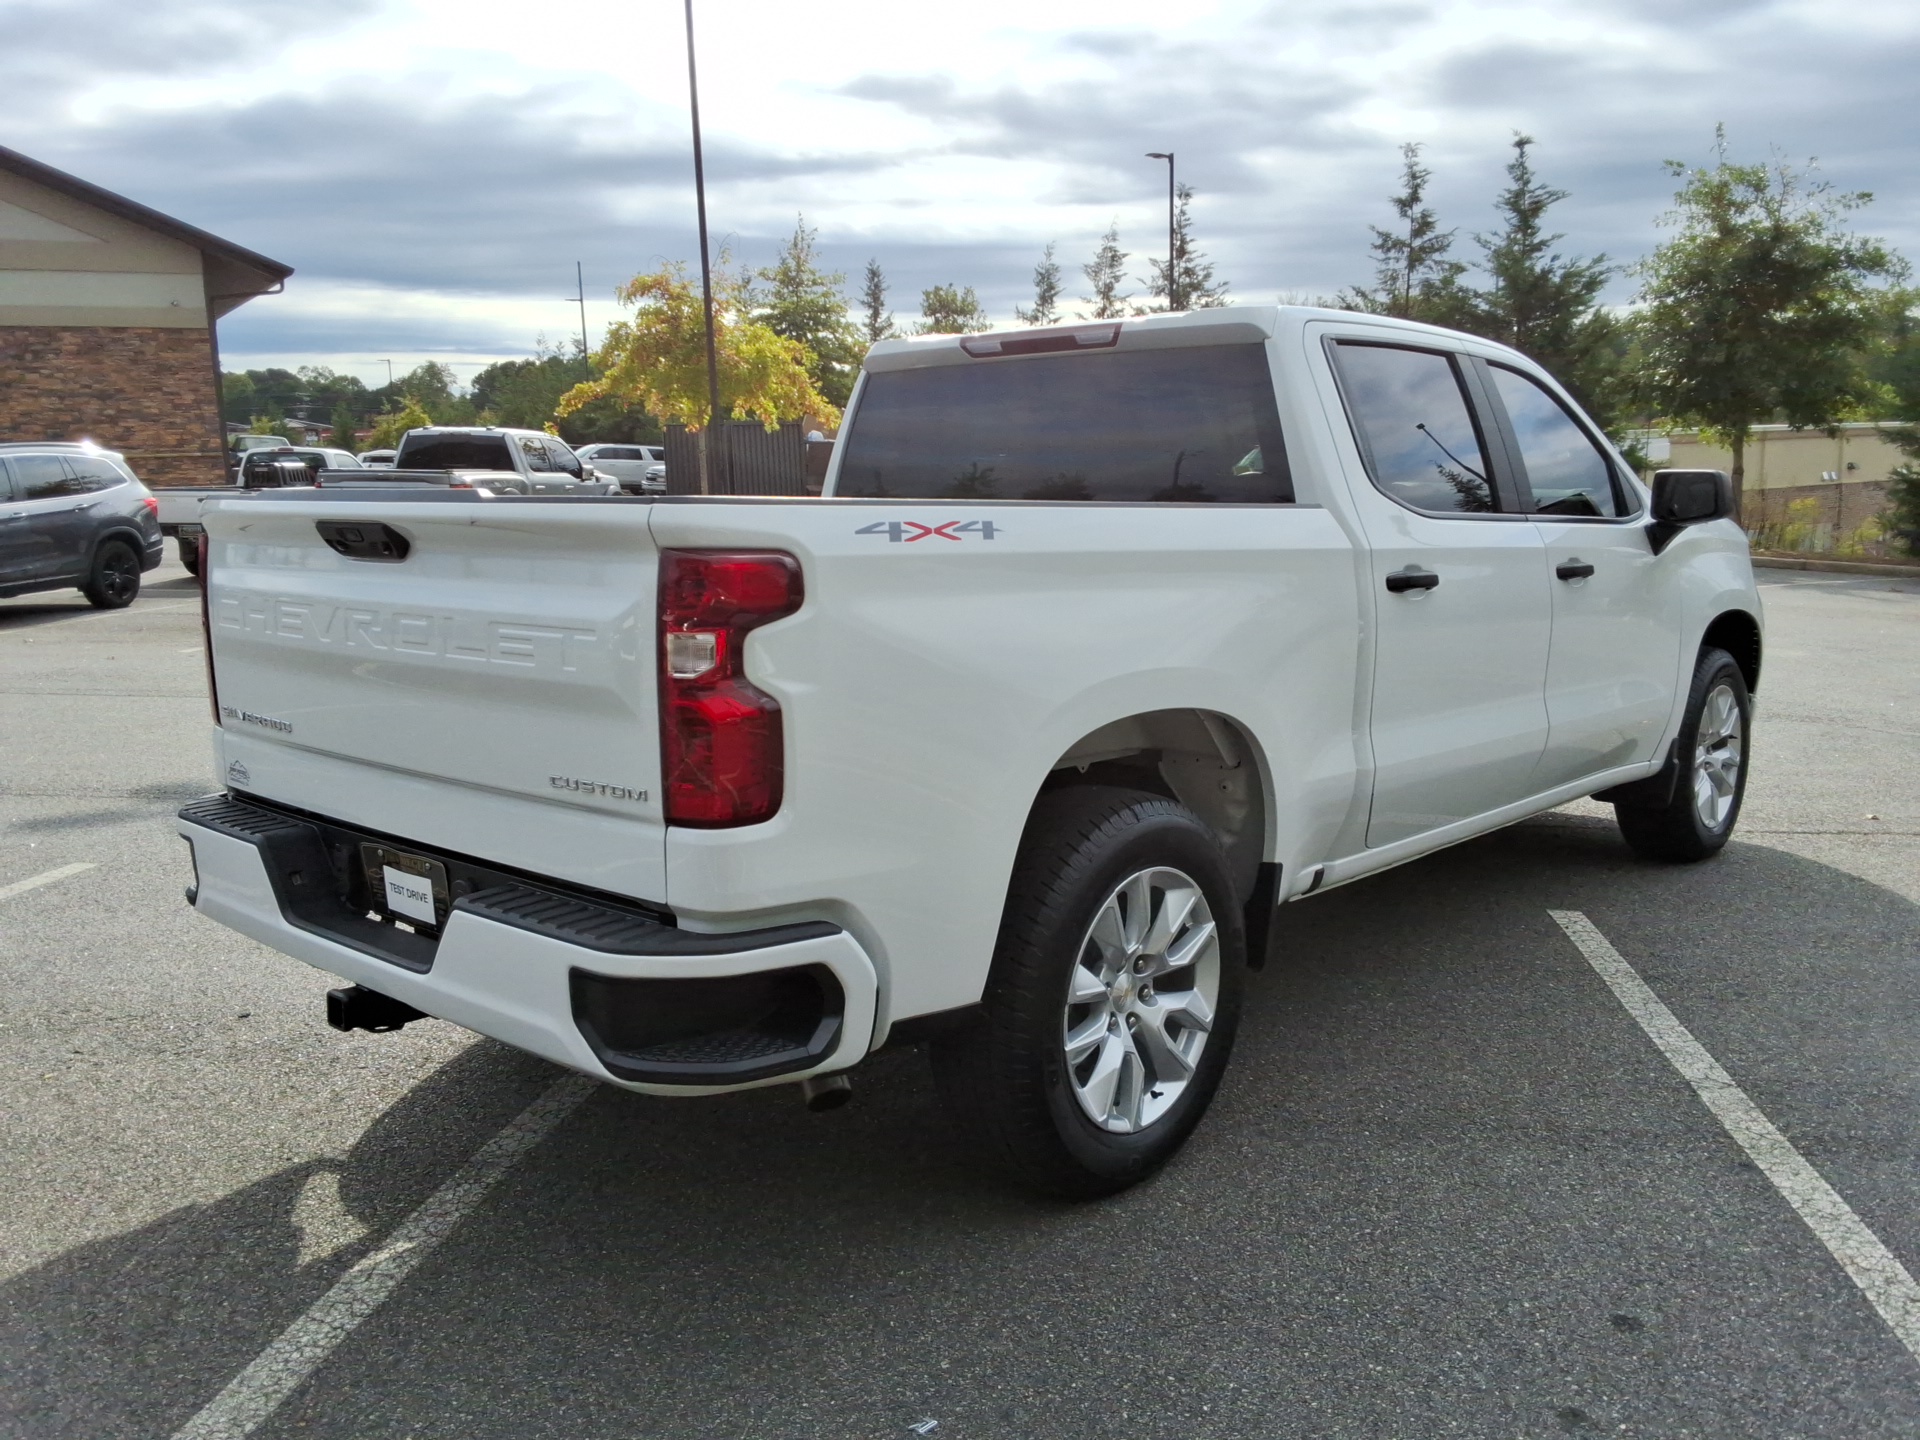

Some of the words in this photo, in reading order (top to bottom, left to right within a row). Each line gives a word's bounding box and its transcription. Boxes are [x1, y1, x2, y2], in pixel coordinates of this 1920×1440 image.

[215, 597, 597, 671] CHEVROLET
[221, 705, 292, 733] SILVERADO
[549, 774, 648, 802] CUSTOM
[389, 882, 405, 896] TEST
[406, 888, 429, 904] DRIVE
